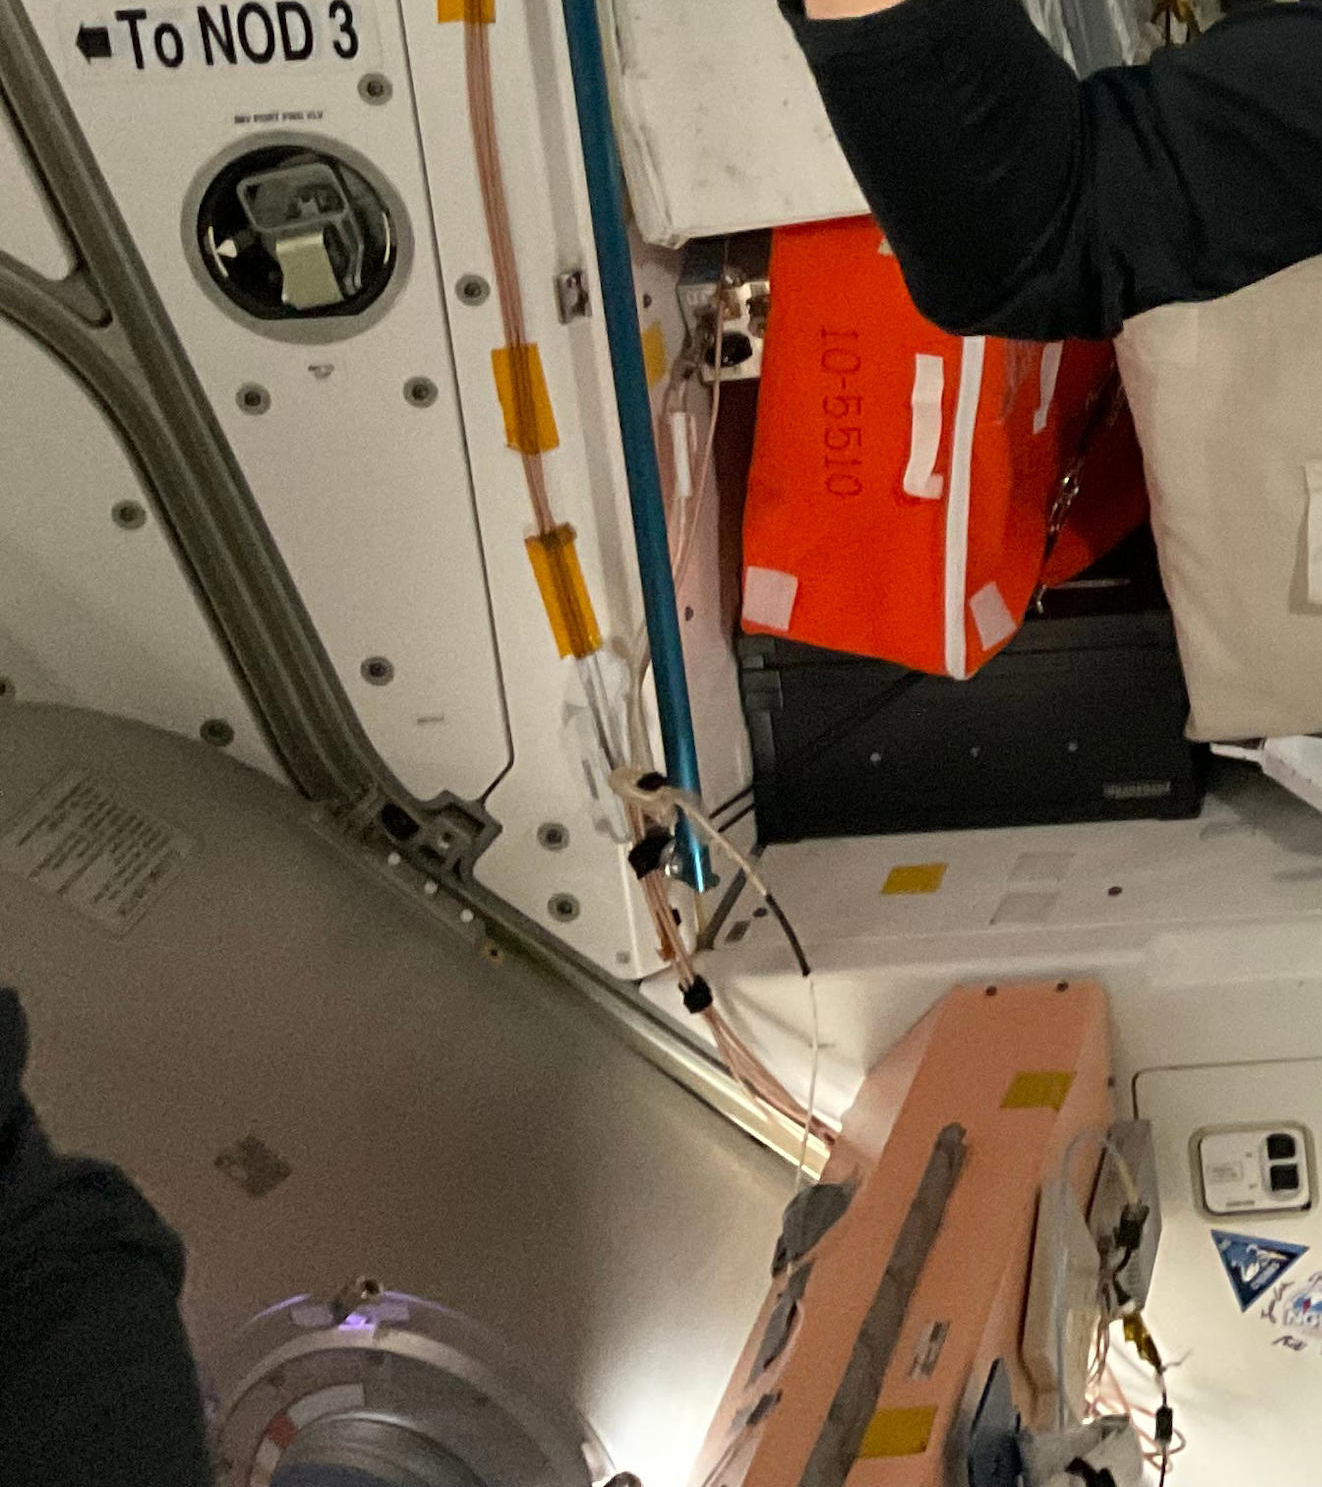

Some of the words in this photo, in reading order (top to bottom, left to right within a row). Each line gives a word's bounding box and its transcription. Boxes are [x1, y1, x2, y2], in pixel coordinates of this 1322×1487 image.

[114, 9, 184, 69] To
[196, 0, 314, 66] NOD
[328, 0, 359, 60] 3
[820, 325, 863, 497] 10-5510
